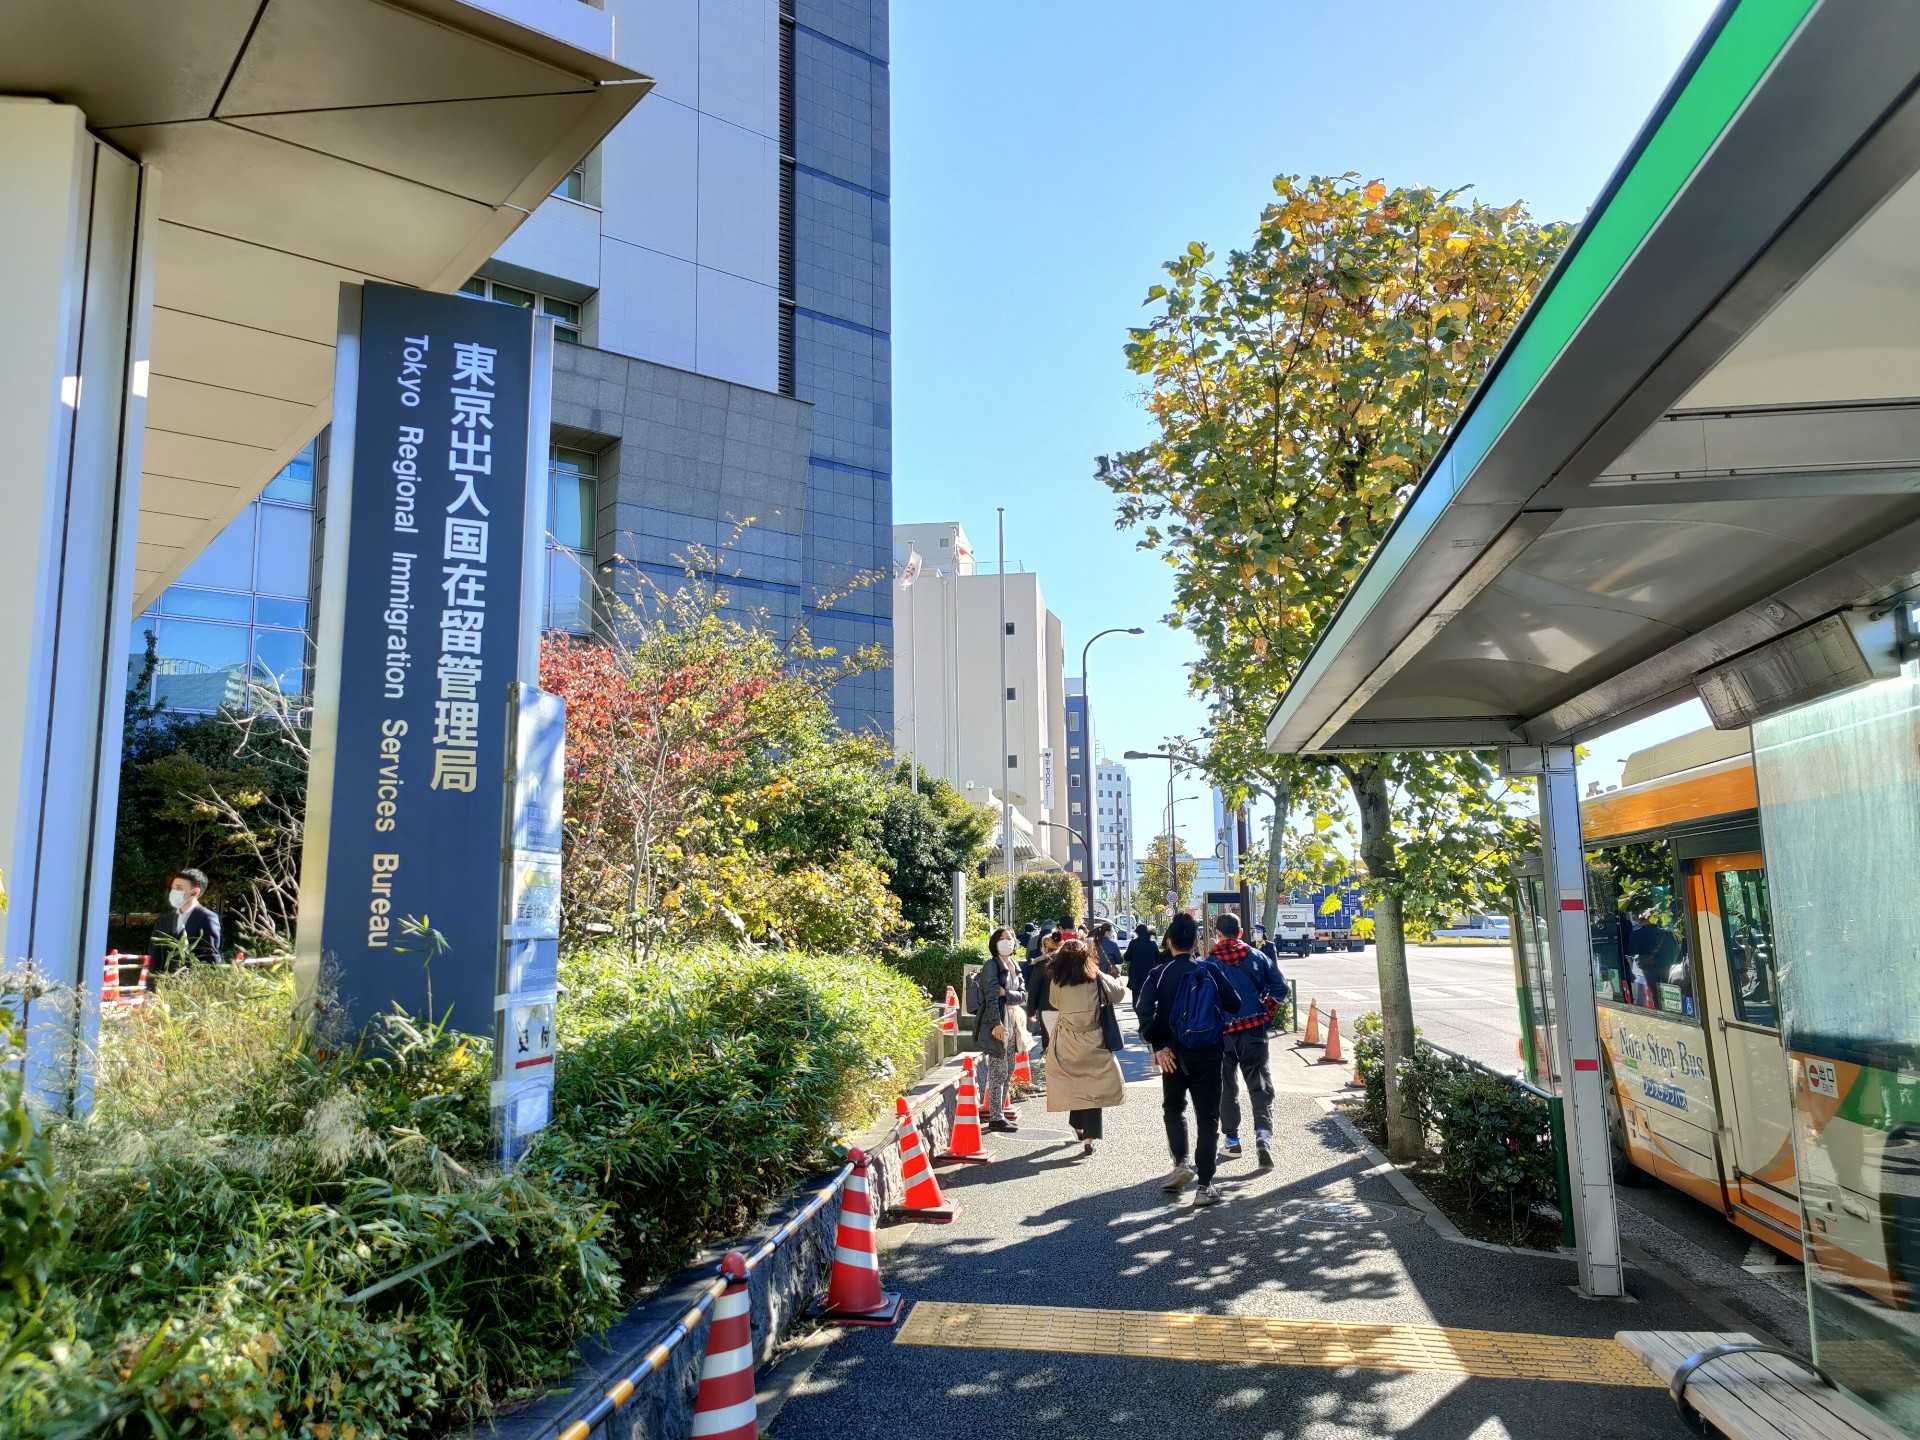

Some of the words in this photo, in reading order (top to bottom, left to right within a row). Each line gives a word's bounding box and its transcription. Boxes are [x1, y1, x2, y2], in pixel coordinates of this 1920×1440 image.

[397, 335, 429, 407] Tokyo
[392, 425, 424, 533] Regional
[430, 342, 497, 793] 東京出入国在留管理局
[384, 552, 418, 699] Immigration
[375, 719, 408, 832] Services
[368, 854, 399, 948] Bureau
[1677, 1041, 1705, 1081] Bus
